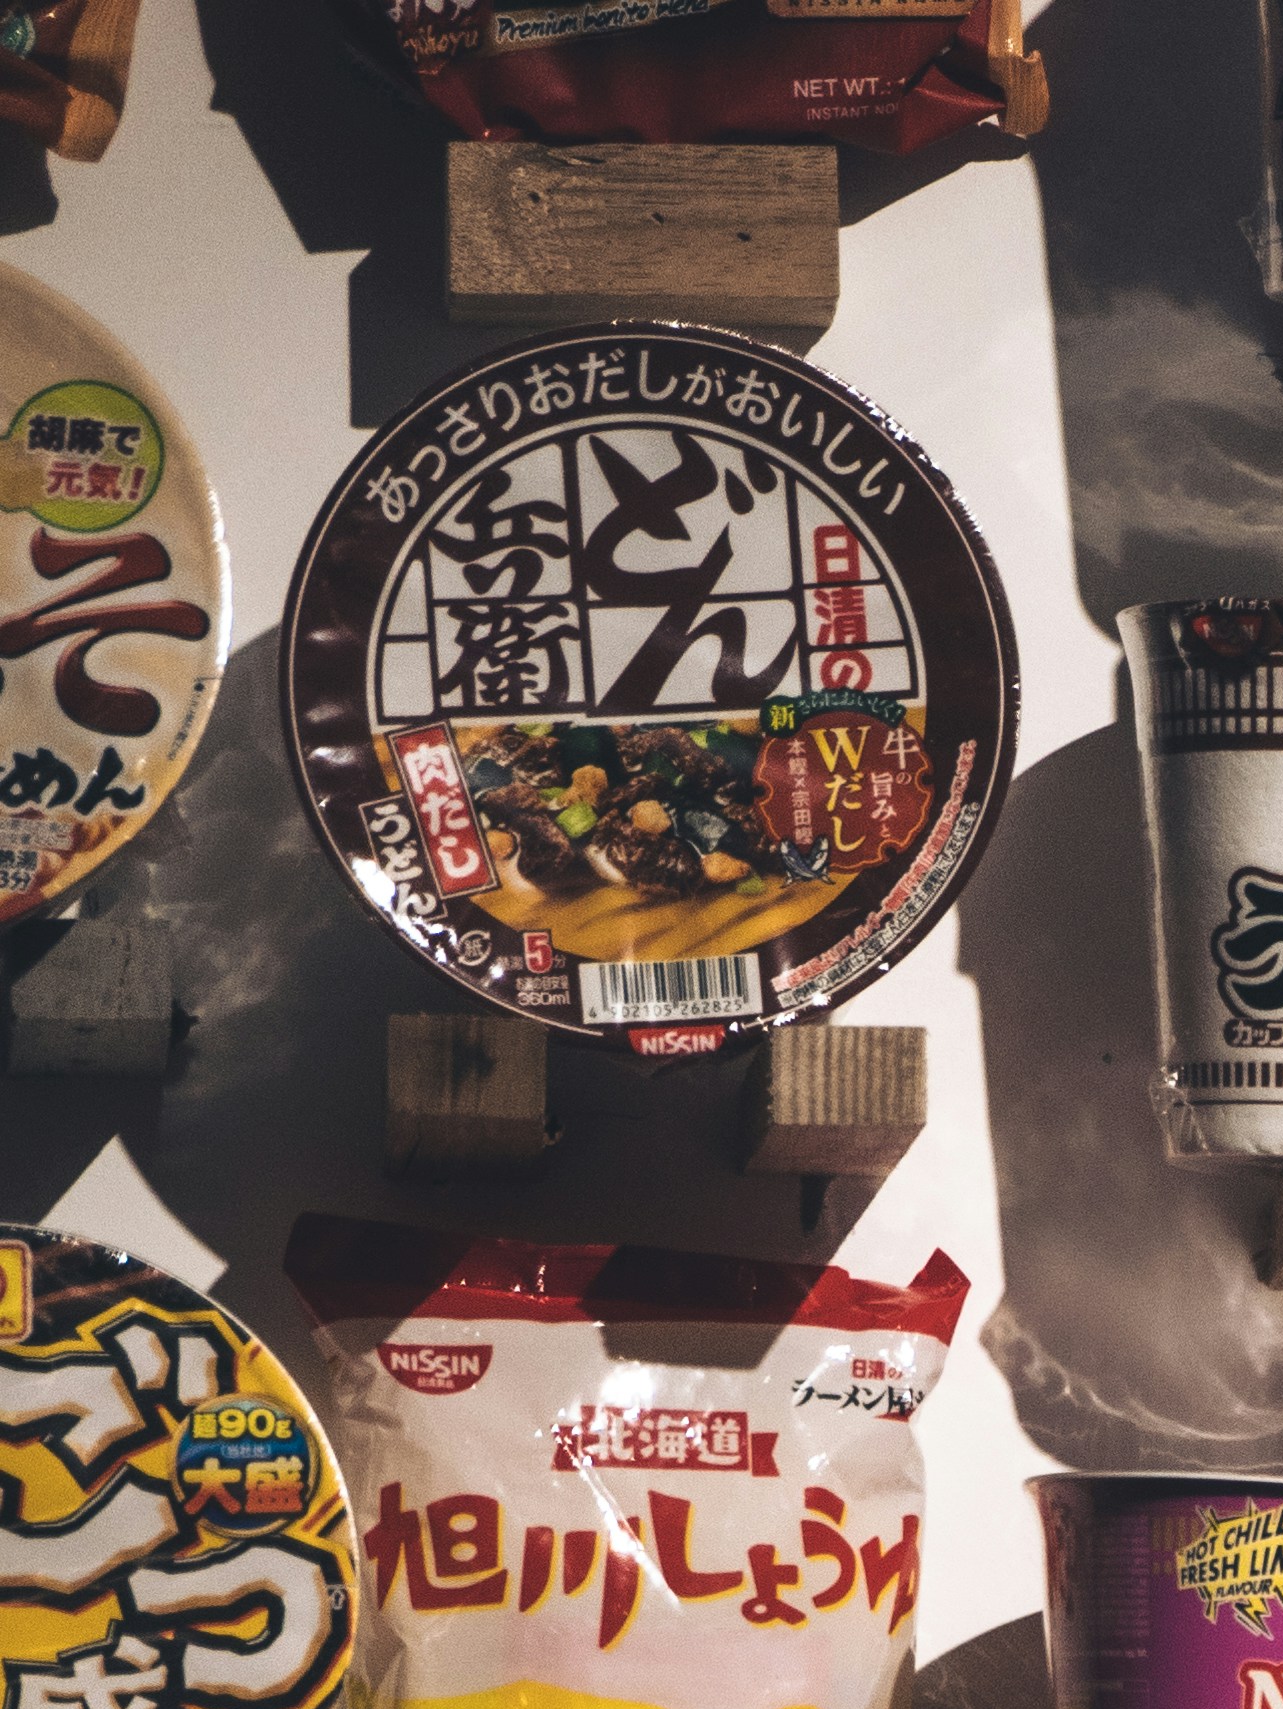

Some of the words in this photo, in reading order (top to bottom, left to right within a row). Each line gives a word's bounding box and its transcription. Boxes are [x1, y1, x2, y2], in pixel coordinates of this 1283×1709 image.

[794, 80, 838, 98] NET
[27, 414, 141, 455] 胡麻で
[363, 347, 908, 522] あっさりおだしがおいしい
[404, 739, 480, 882] 肉だし
[641, 1028, 717, 1054] NISSIN
[389, 1348, 481, 1378] NISSIN
[182, 1466, 306, 1517] 大盛
[363, 1481, 922, 1653] 旭川しょうゆ
[1179, 1556, 1243, 1586] FRESH
